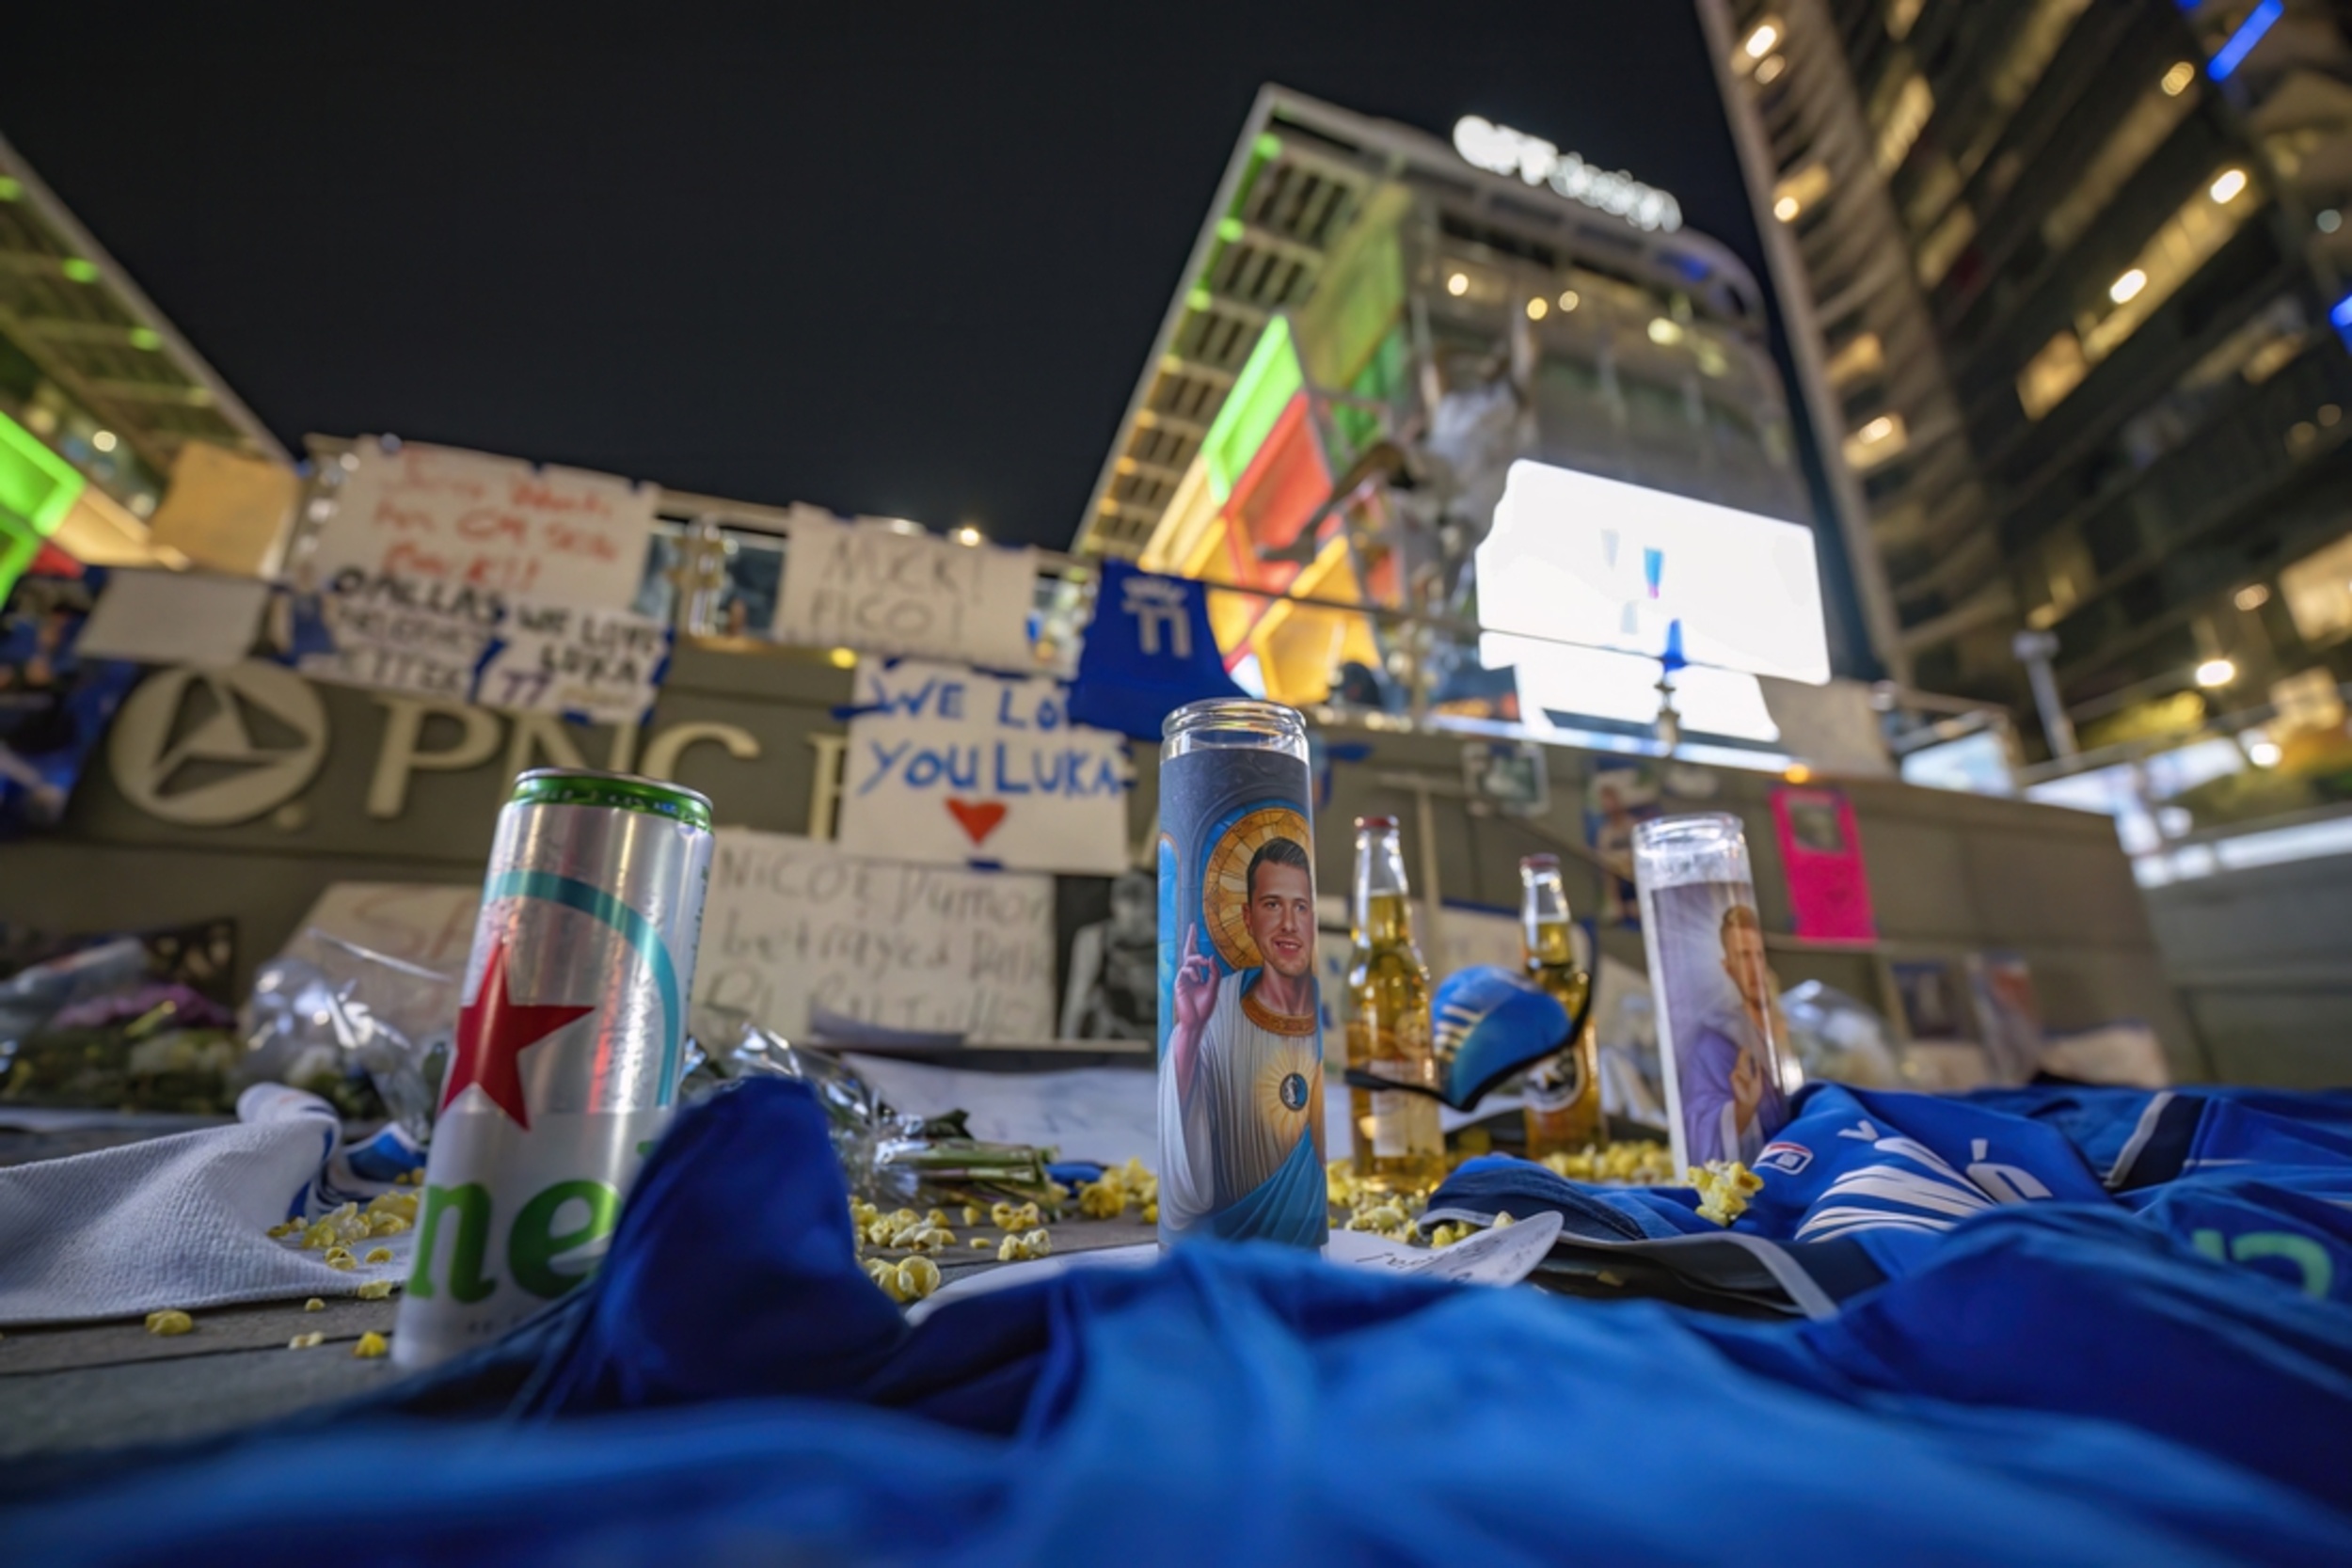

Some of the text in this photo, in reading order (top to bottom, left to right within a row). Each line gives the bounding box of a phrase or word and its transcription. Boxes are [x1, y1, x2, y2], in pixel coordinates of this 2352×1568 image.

[870, 674, 1070, 730] WE LO
[859, 740, 980, 798] YOU
[995, 742, 1120, 800] LUKA
